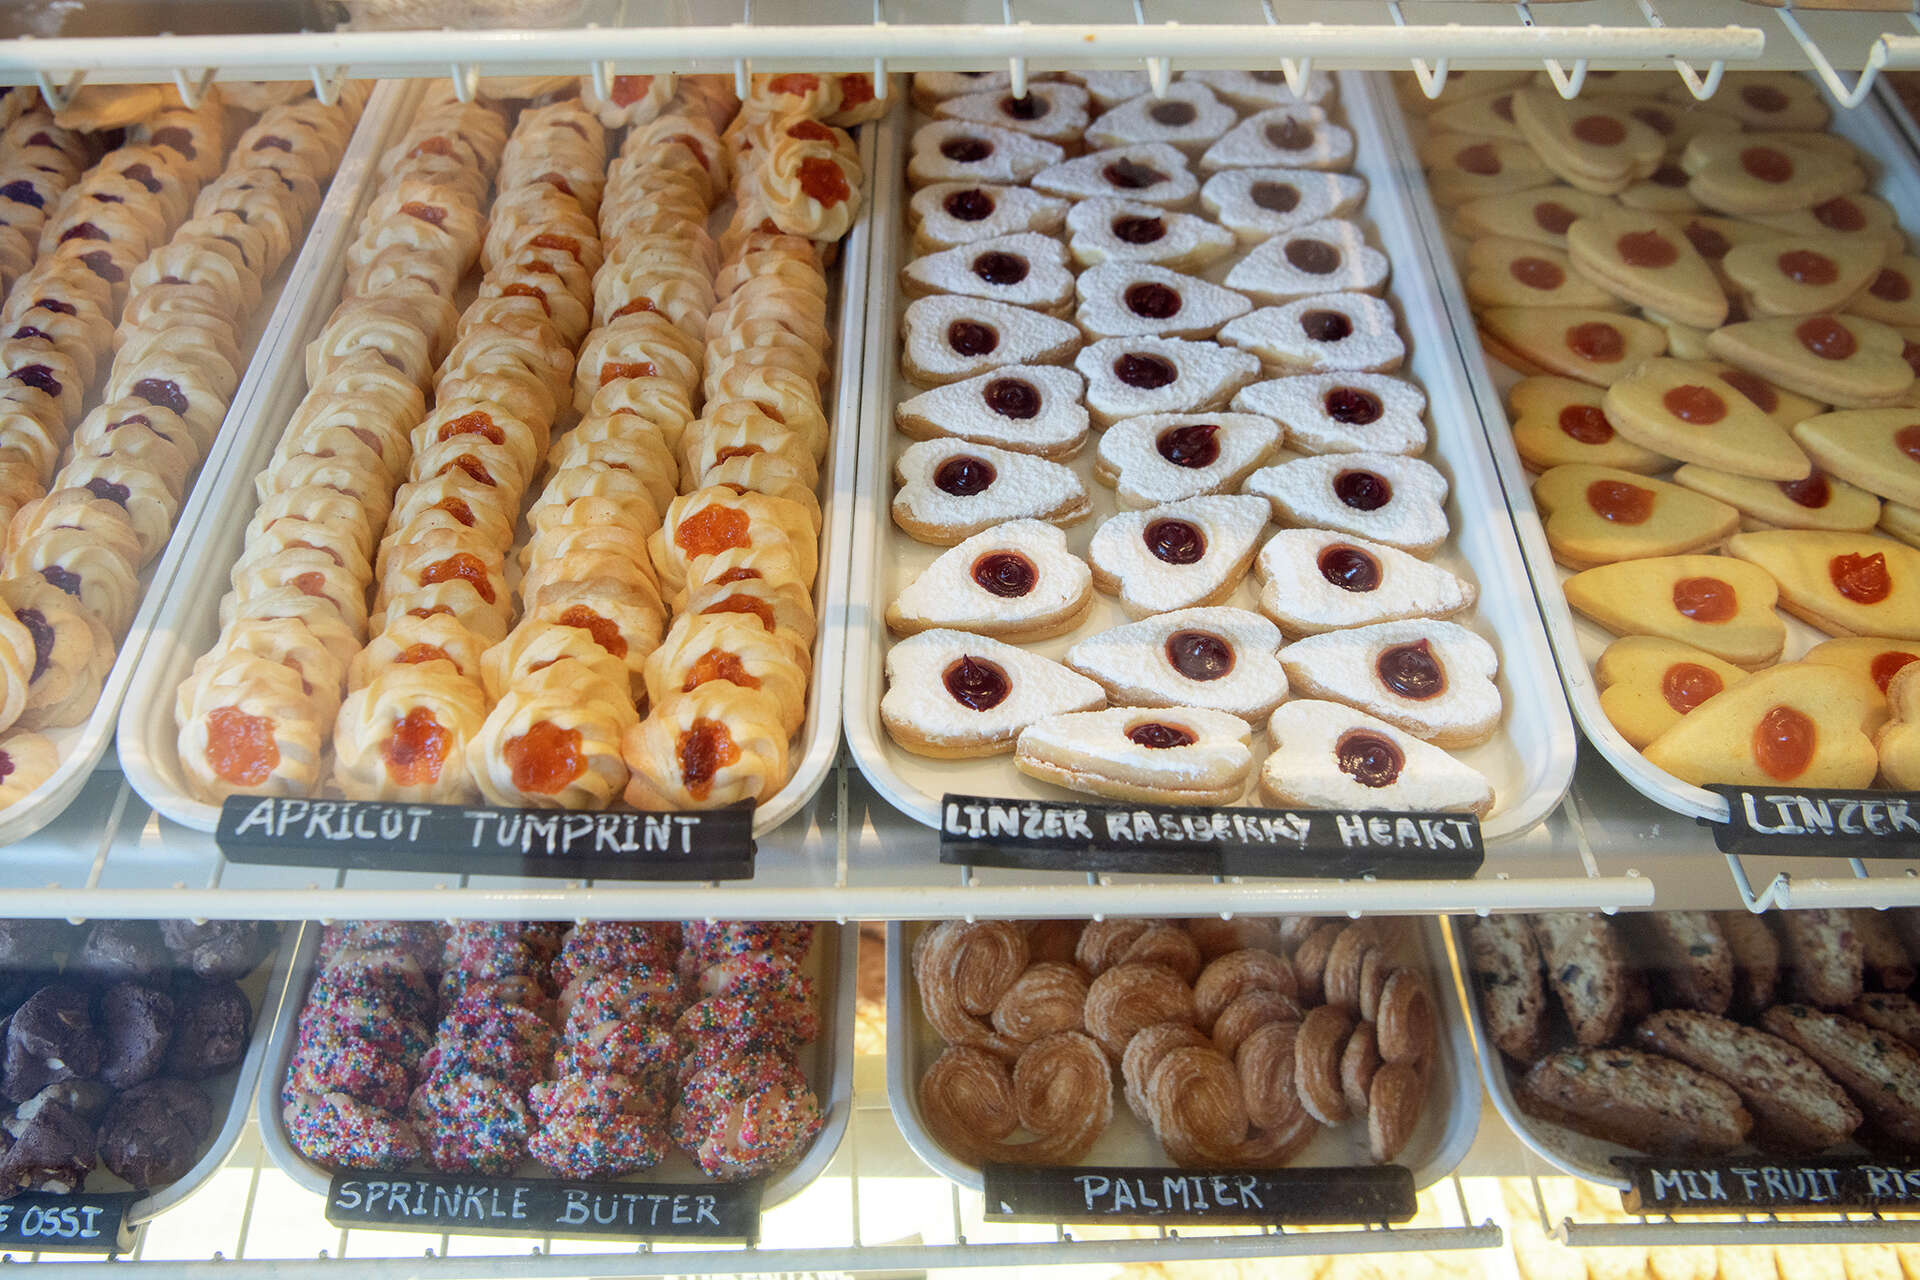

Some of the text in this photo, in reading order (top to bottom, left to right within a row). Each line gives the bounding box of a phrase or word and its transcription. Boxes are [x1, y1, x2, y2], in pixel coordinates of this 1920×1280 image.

[235, 797, 701, 854] APRICOT TUMPRINT
[945, 802, 1094, 839] LINZER
[1741, 792, 1920, 836] LINZER
[1073, 1175, 1264, 1212] PALMIER
[1650, 1168, 1728, 1202] MIX
[1730, 1167, 1841, 1202] FRUIT
[20, 1204, 104, 1238] OSSI
[335, 1181, 720, 1226] SPRINKLE BUTTER
